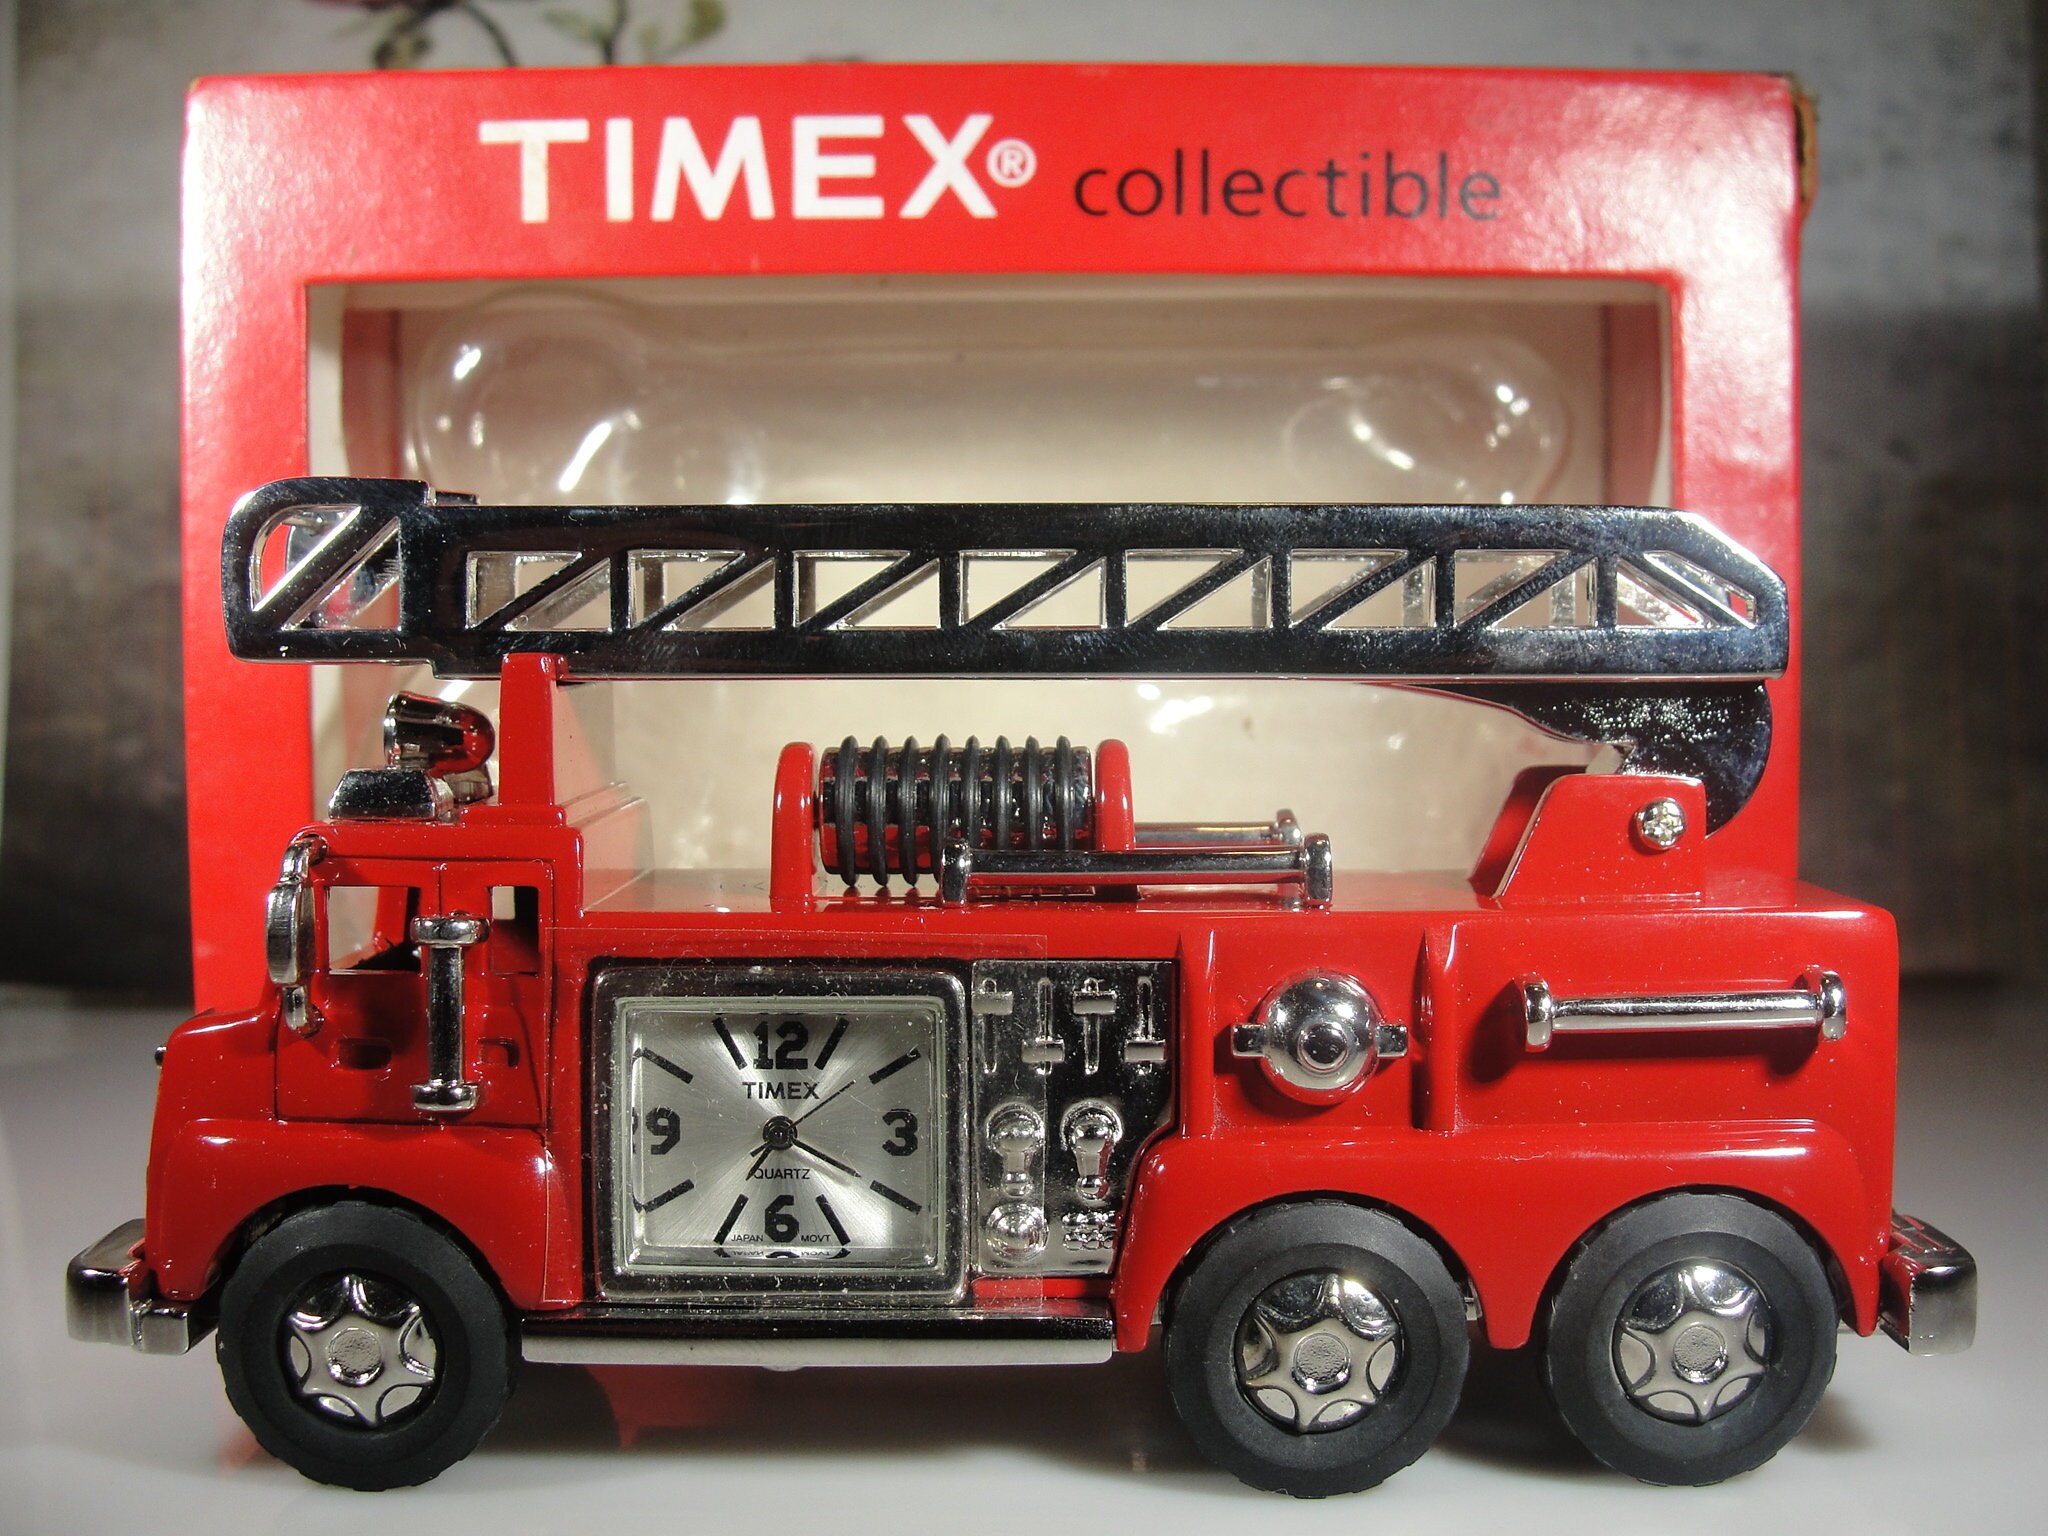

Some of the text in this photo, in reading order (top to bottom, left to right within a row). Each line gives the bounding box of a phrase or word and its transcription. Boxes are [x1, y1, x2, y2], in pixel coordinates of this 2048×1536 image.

[1073, 148, 1504, 221] collectible
[752, 1020, 809, 1070] 12
[742, 1081, 820, 1100] TIMEX
[645, 1106, 681, 1155] 9
[881, 1108, 919, 1157] 3
[753, 1167, 811, 1180] QUARTZ
[730, 1234, 832, 1243] JAPAN MOVT
[764, 1194, 800, 1243] 6
